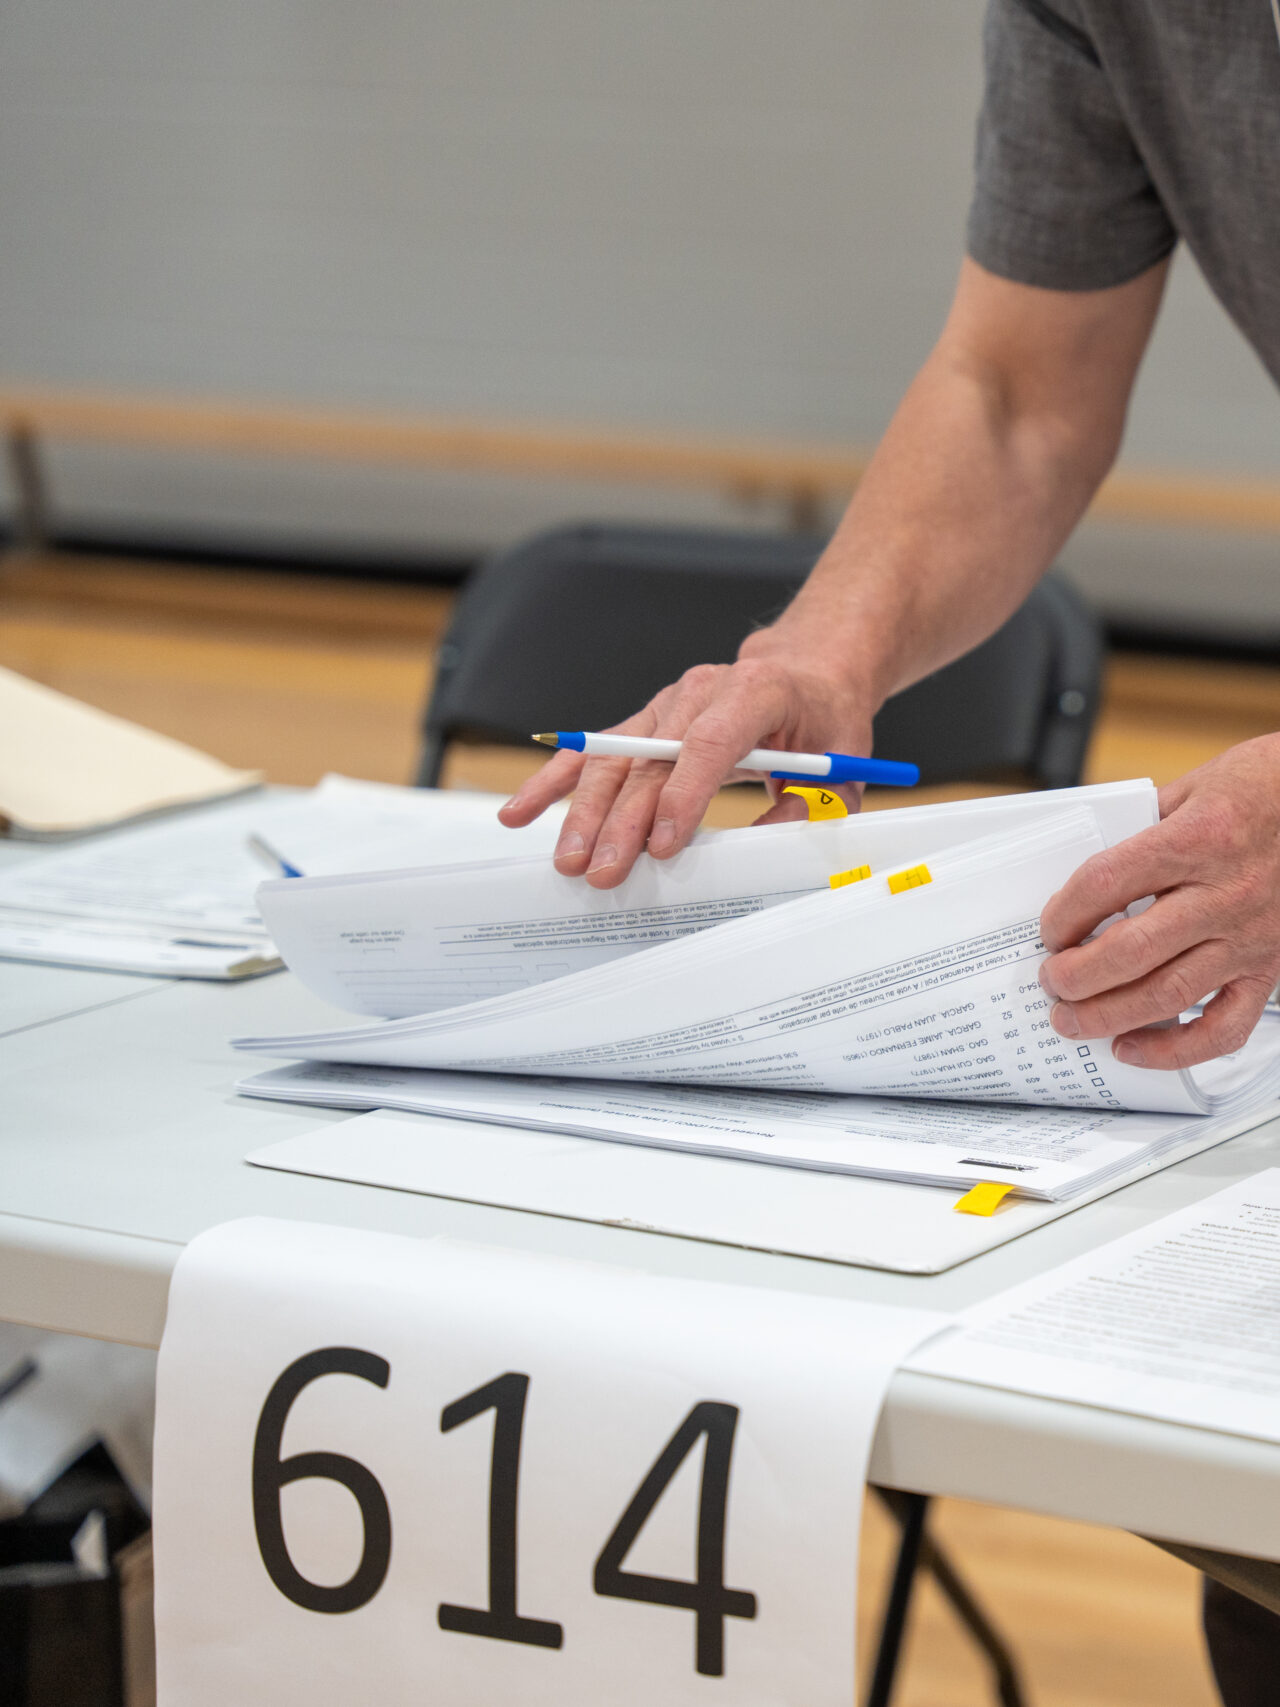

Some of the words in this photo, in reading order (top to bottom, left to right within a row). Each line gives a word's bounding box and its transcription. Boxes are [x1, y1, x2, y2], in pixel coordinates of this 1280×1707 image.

[1013, 949, 1021, 957] X
[975, 961, 984, 969] at
[984, 954, 1006, 967] Voted
[939, 963, 975, 981] Advanced
[912, 982, 919, 990] A
[923, 975, 939, 987] Poll
[884, 989, 895, 998] au
[895, 983, 912, 996] voté
[859, 993, 884, 1007] bureau
[989, 991, 1006, 1003] 416
[831, 1005, 847, 1015] vote
[848, 1002, 858, 1010] de
[939, 1001, 975, 1019] GARCIA,
[1023, 998, 1048, 1012] 133-0
[818, 1009, 830, 1019] par
[913, 1013, 937, 1027] JUAN
[1001, 1010, 1012, 1020] 52
[778, 1014, 817, 1030] anticipation
[883, 1020, 912, 1036] PABLO
[944, 1019, 981, 1037] GARCIA,
[1030, 1019, 1050, 1031] 58-0
[855, 1029, 882, 1043] (1971)
[917, 1031, 944, 1045] JAIME
[1036, 1035, 1060, 1048] 155-0
[868, 1038, 917, 1058] FERNANDO
[940, 1043, 965, 1057] SHAN
[965, 1037, 988, 1050] GAO,
[842, 1050, 867, 1063] (1965)
[912, 1050, 939, 1063] (1987)
[1015, 1046, 1025, 1055] 37
[956, 1059, 972, 1069] CUI
[972, 1053, 995, 1065] GAO,
[1043, 1052, 1067, 1065] 156-0
[936, 1063, 955, 1072] HUA
[1016, 1061, 1033, 1071] 410
[920, 1076, 960, 1086] MITCHELL
[961, 1068, 1003, 1081] GAMMON,
[1024, 1075, 1040, 1083] 409
[252, 1346, 758, 1678] 614
